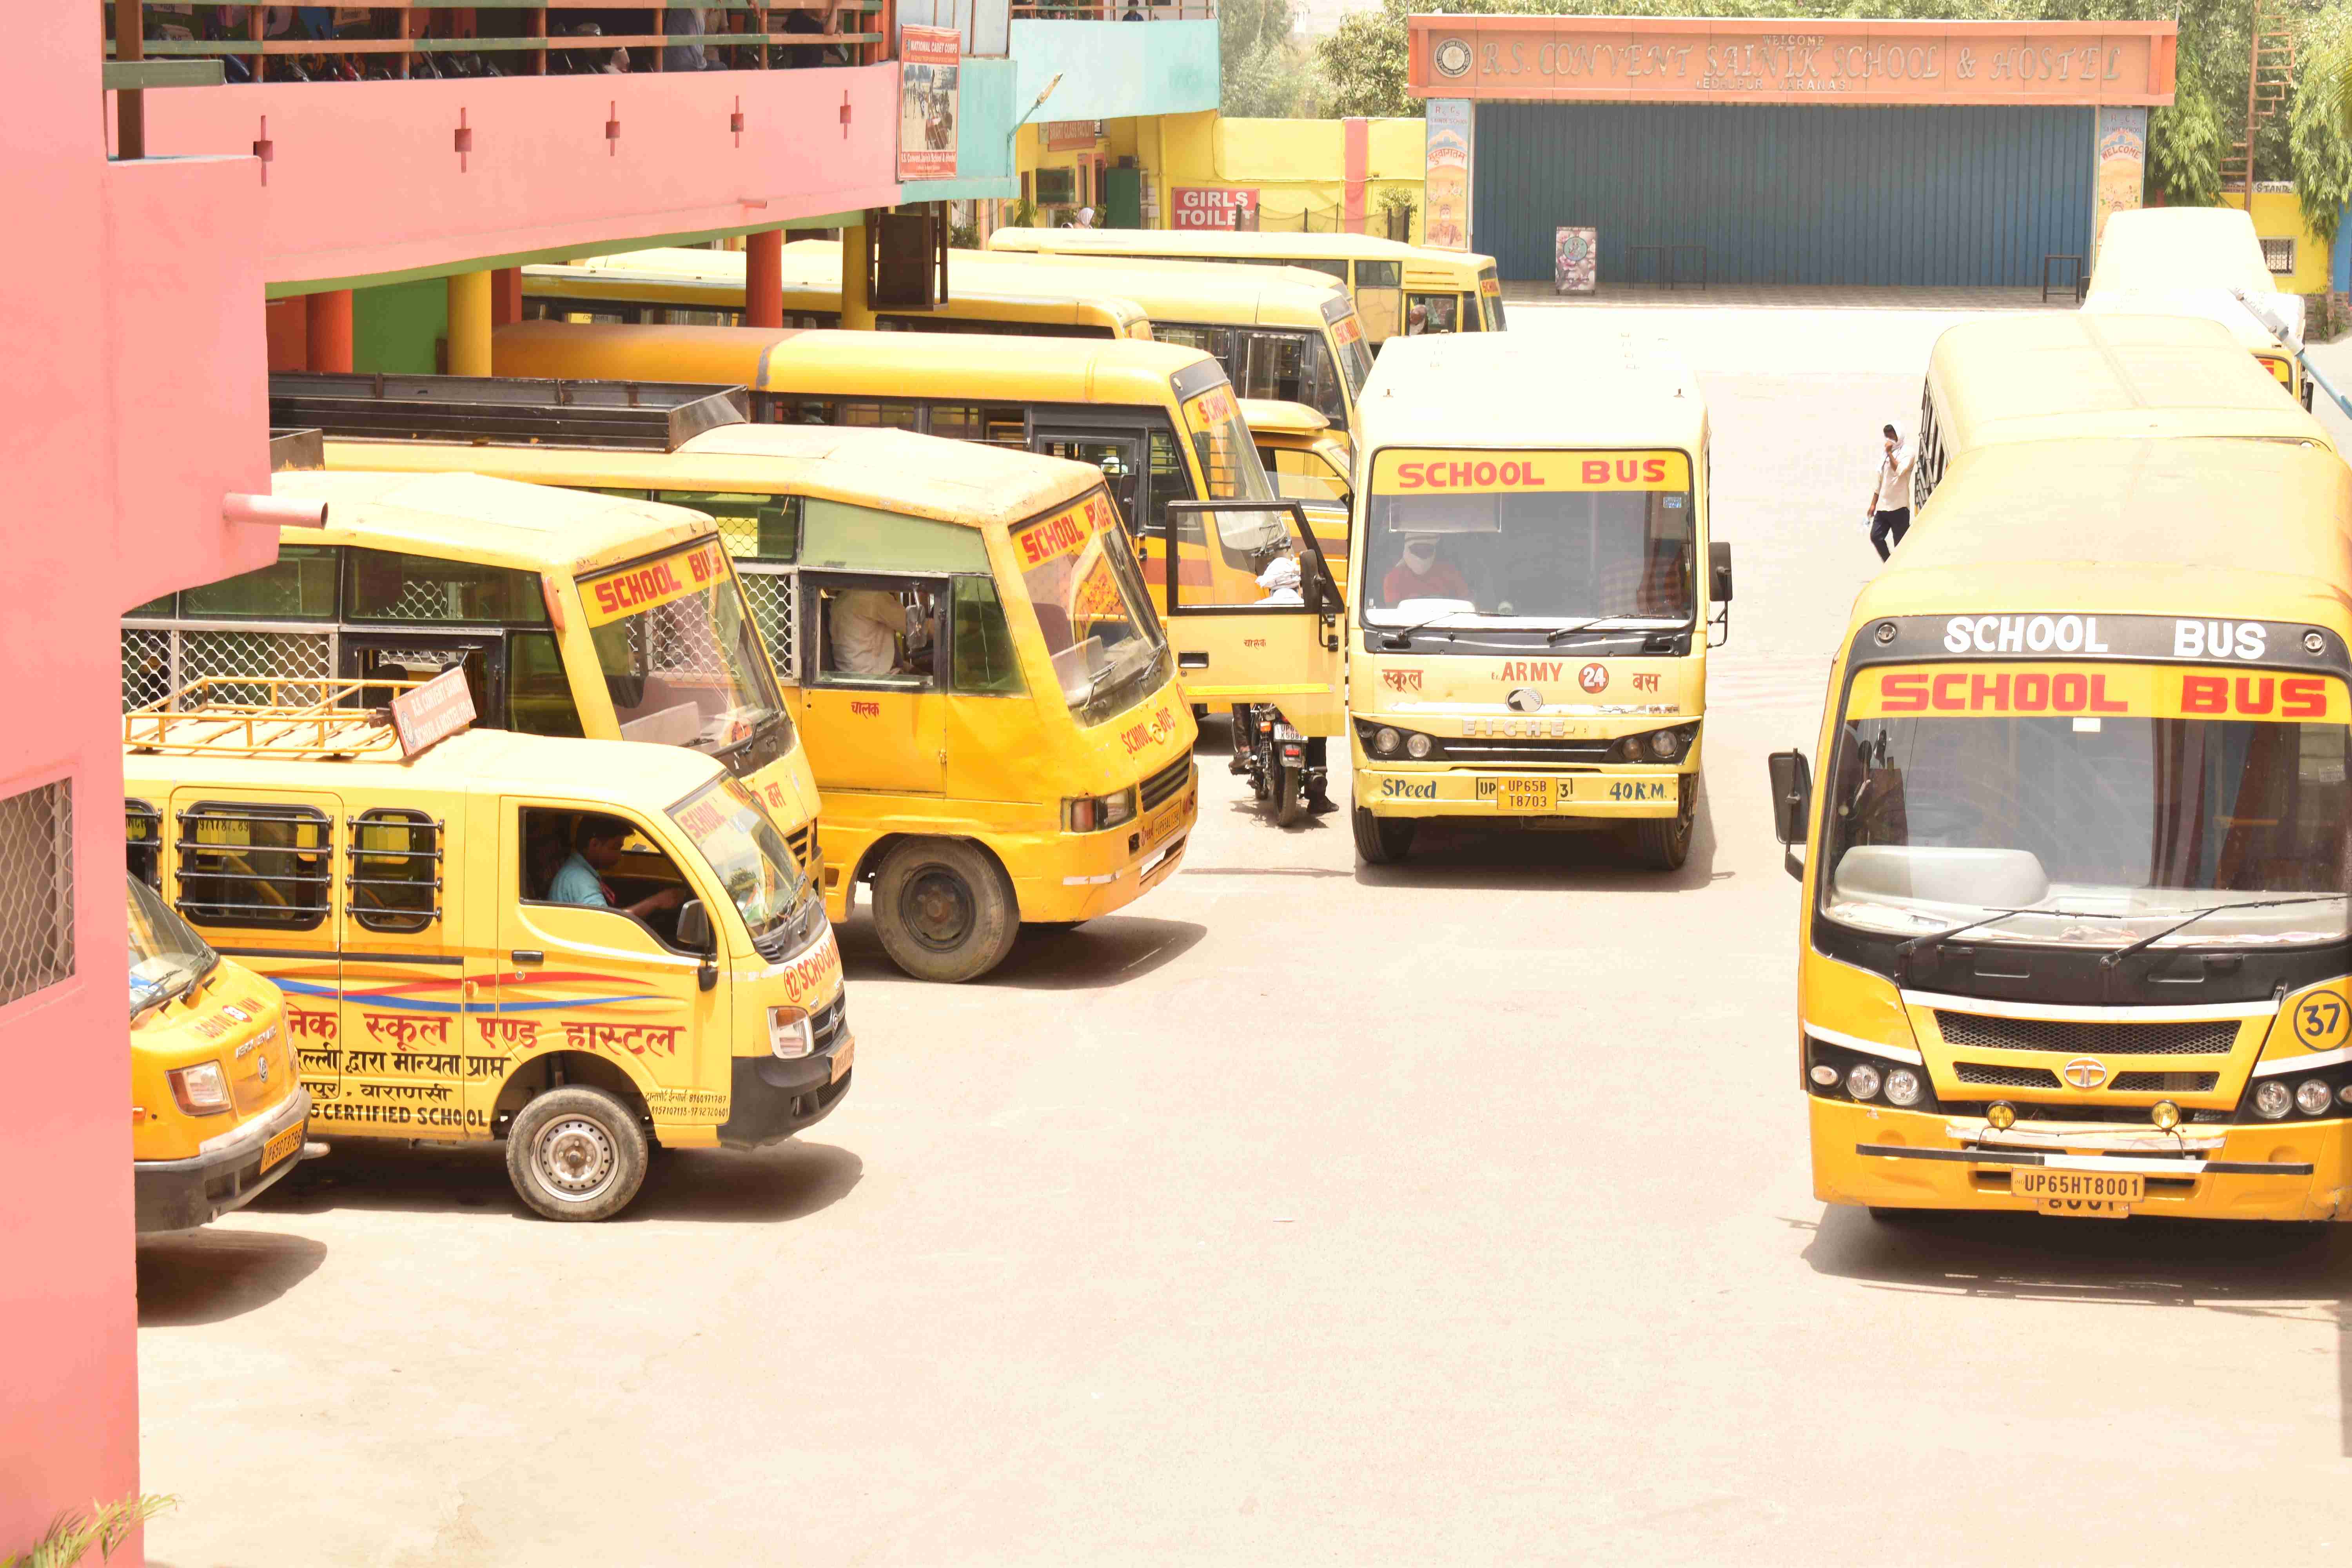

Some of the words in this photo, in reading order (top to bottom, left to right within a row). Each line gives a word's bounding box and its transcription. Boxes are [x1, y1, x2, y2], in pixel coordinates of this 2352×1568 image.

[911, 41, 930, 52] NATIONAL
[931, 42, 944, 53] CADET
[945, 44, 957, 54] CORPS
[1763, 35, 1825, 46] WELCOME
[1482, 42, 1530, 75] R.S.
[1540, 42, 1694, 77] CONVENT
[1704, 44, 1822, 78] SAINIK
[1831, 44, 1940, 78] SCHOOL
[1956, 47, 1976, 79] &
[1991, 47, 2121, 80] HOSTEL
[2101, 145, 2142, 160] WELCOME
[1183, 191, 1248, 207] GIRLS
[1397, 461, 1545, 488] SCHOOL
[1581, 459, 1666, 484] BUS
[1021, 514, 1085, 564] SCHOOL
[595, 562, 683, 615] SCHOOL
[687, 545, 724, 583] BUS
[1944, 615, 2107, 653] SCHOOL
[2173, 620, 2266, 659] BUS
[1381, 668, 1424, 694] स्कूल
[1501, 662, 1563, 682] ARMY
[1583, 666, 1606, 687] 24
[1632, 673, 1661, 695] बस
[1881, 673, 2128, 712] SCHOOL
[2180, 675, 2327, 718] BUS
[851, 701, 880, 719] चालक
[1121, 722, 1153, 755] SCHOOL
[1155, 706, 1176, 737] BUS
[1479, 782, 1496, 795] UP
[1508, 780, 1547, 792] UP65B
[1508, 795, 1547, 807] T8703
[786, 971, 800, 998] 12
[797, 942, 836, 990] SCHOOL
[2302, 1003, 2340, 1036] 37
[363, 1013, 454, 1052] स्कूल
[477, 1018, 542, 1049] एण्ड
[561, 1021, 687, 1058] हास्टल
[345, 1051, 388, 1074] द्वारा
[390, 1052, 461, 1078] मान्यता
[465, 1055, 512, 1078] प्राप्त
[360, 1083, 453, 1104] वाराणसी
[689, 1094, 727, 1103] 8960971787
[323, 1103, 411, 1125] CERTIFIED
[417, 1107, 488, 1127] SCHOOL
[2025, 1174, 2138, 1196] UP65HT8001
